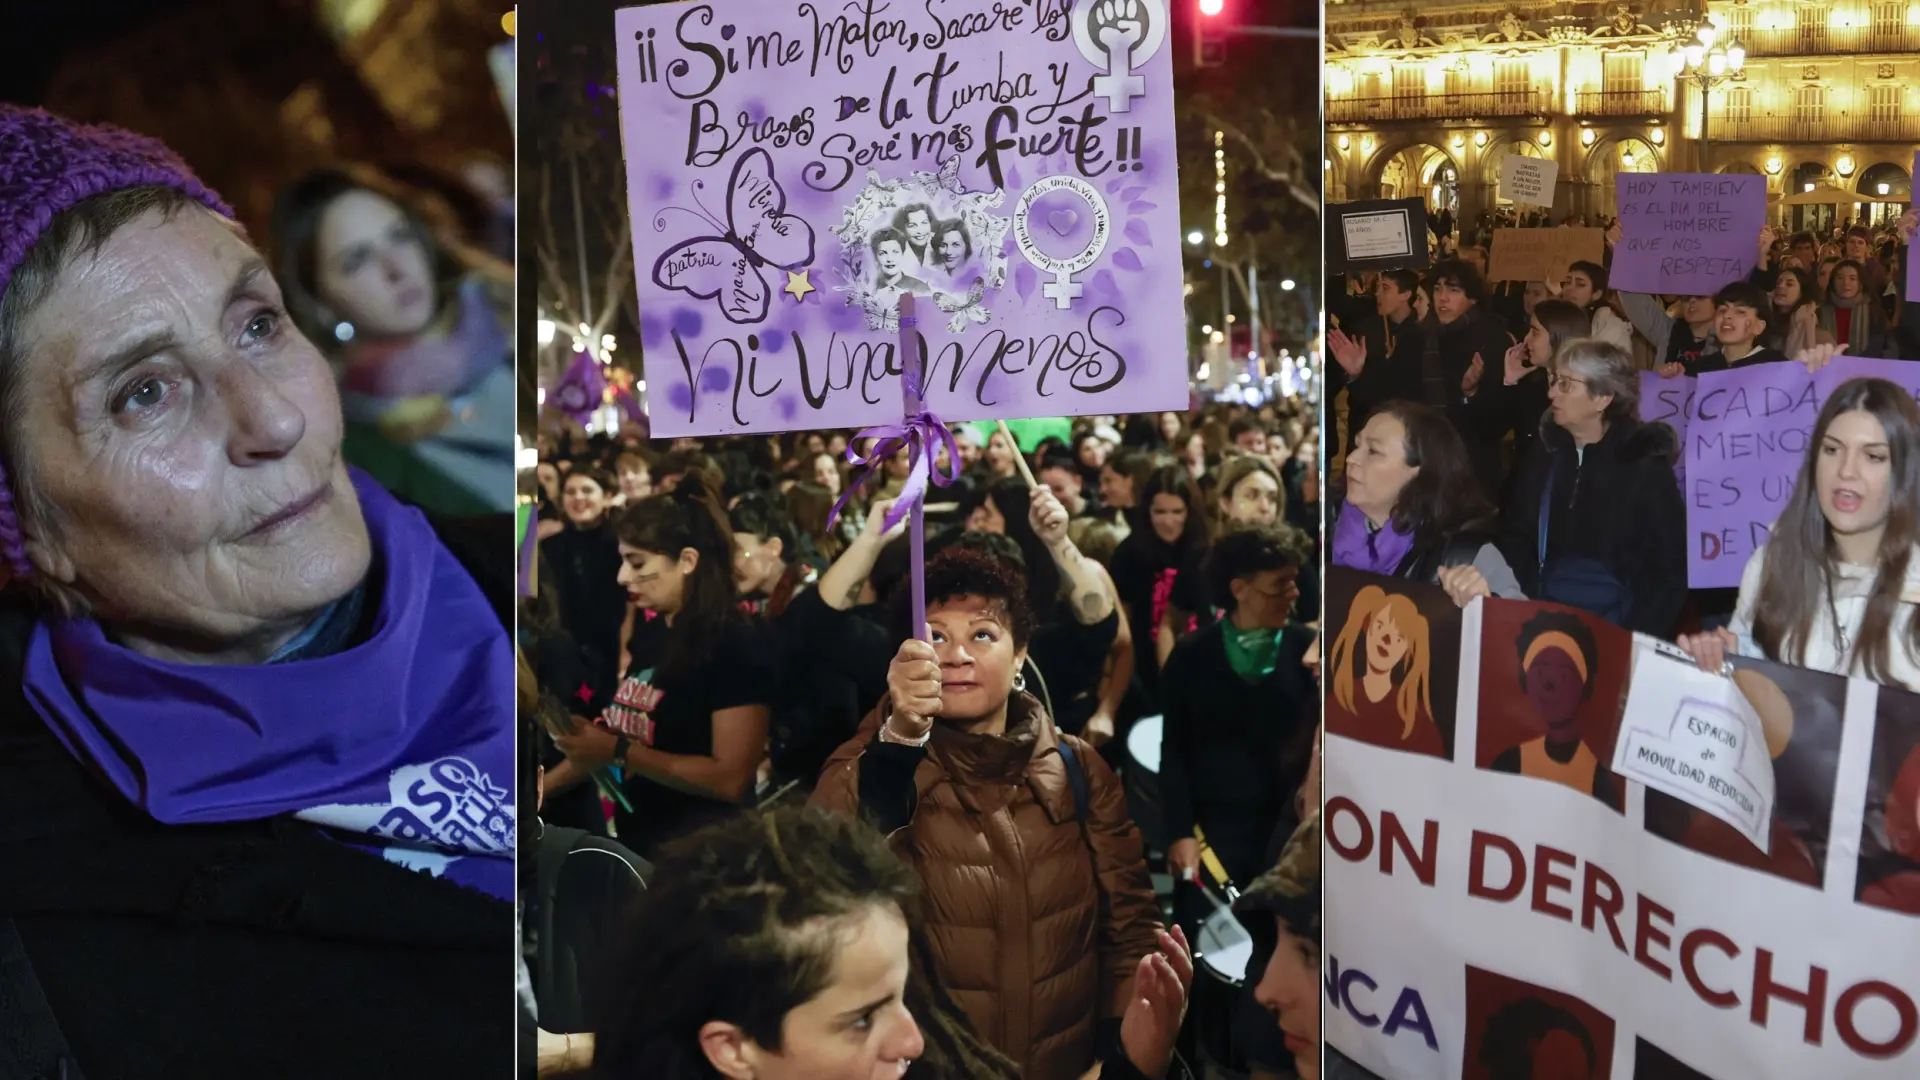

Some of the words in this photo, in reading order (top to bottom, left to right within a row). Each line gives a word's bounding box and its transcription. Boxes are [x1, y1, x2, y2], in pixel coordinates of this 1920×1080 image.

[685, 99, 815, 167] Brazos
[1627, 181, 1658, 196] HOY
[1623, 202, 1638, 215] ES
[1645, 202, 1665, 214] EL
[1698, 202, 1732, 214] DEL
[1664, 217, 1731, 233] HOMBRE
[1627, 238, 1663, 251] QUE
[1672, 238, 1702, 252] NOS
[1660, 256, 1742, 276] RESPETA
[1697, 379, 1820, 421] CADA
[1693, 477, 1741, 509] ES
[1700, 527, 1738, 561] DE
[1687, 716, 1737, 749] ESPACIO
[1700, 748, 1716, 762] de
[1637, 746, 1706, 785] MOVILIDAD
[1708, 775, 1755, 816] REDUCIDA
[1324, 795, 1439, 887] ON
[1467, 828, 1919, 1060] DERECHO
